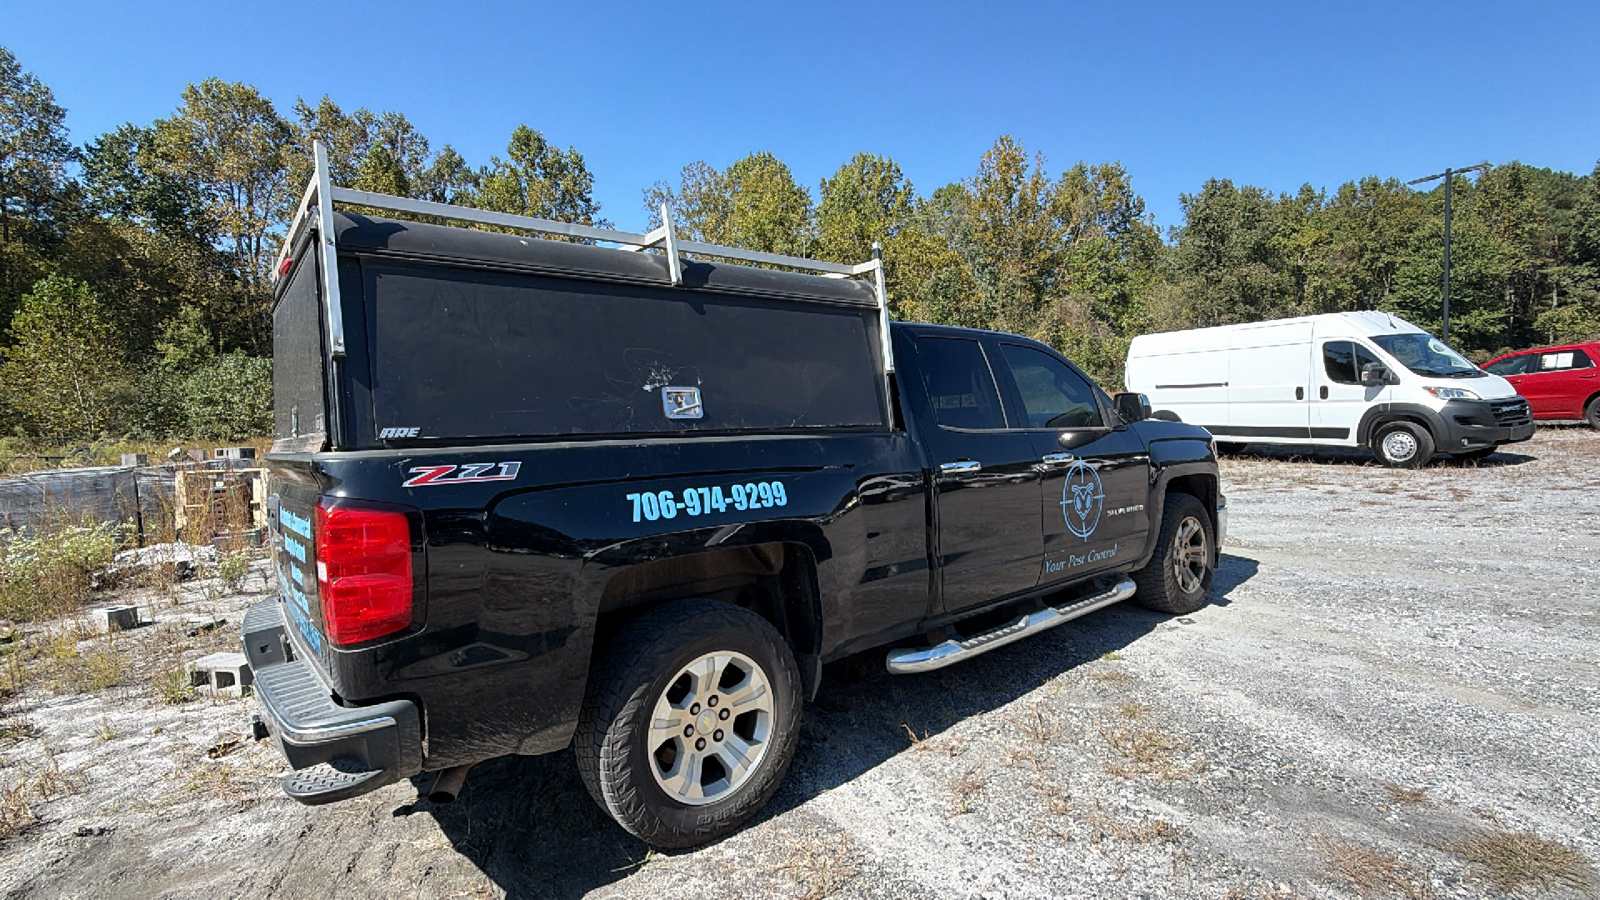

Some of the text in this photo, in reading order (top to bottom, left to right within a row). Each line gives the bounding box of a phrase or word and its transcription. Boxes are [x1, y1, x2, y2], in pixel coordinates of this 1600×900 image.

[379, 427, 421, 439] ARE
[402, 461, 522, 488] Z71
[626, 481, 788, 523] 706-974-9299
[1045, 542, 1118, 573] Your Pest Control
